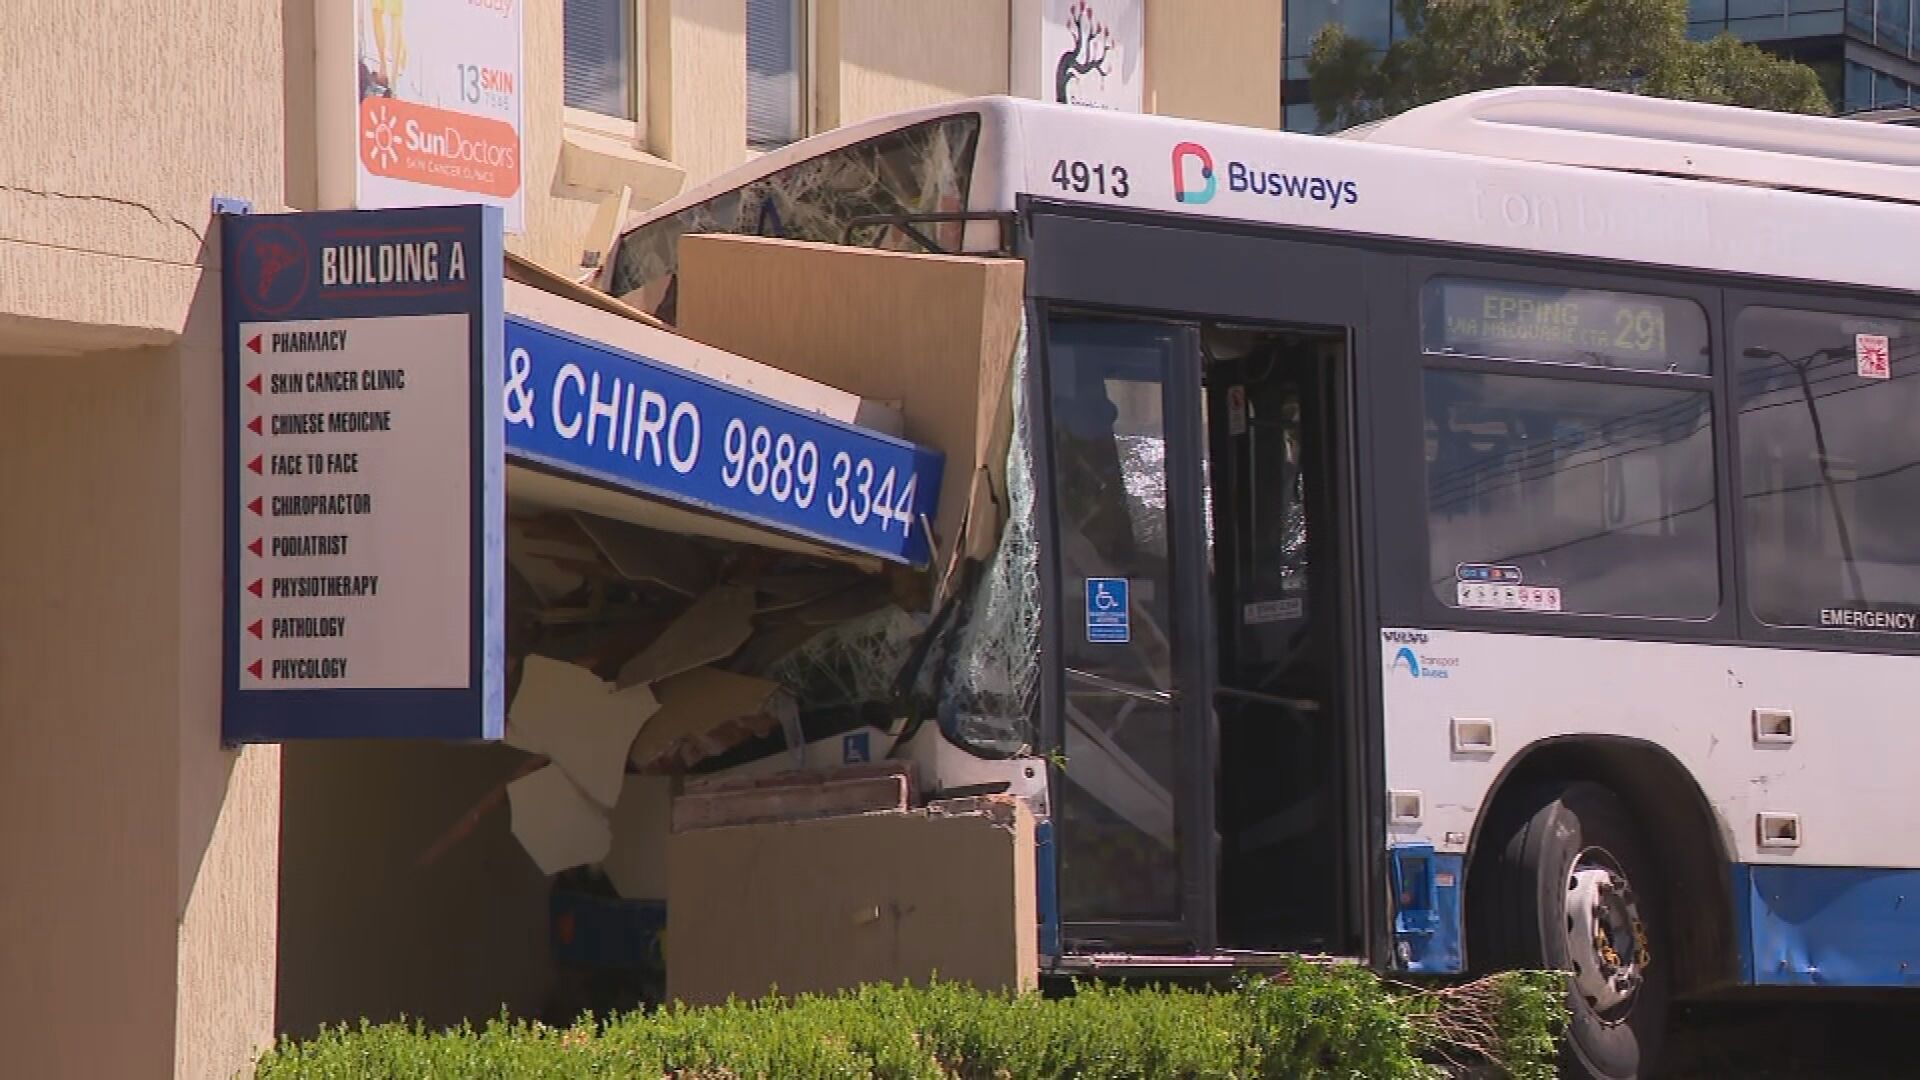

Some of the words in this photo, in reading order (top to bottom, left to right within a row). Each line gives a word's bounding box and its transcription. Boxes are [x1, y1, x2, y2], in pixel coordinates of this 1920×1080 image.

[457, 64, 480, 104] 13
[481, 68, 512, 94] SKIN
[405, 119, 514, 169] SunDoctors
[1051, 159, 1130, 198] 4913
[1228, 161, 1358, 209] Busways
[321, 242, 438, 285] BUILDING
[449, 241, 465, 281] A
[1483, 295, 1579, 325] EPPING
[271, 330, 347, 352] PHARMACY
[1614, 307, 1667, 352] 291
[271, 373, 303, 394] SKIN
[306, 371, 358, 392] CANCER
[362, 369, 405, 390] CLINIC
[271, 413, 325, 435] CHINESE
[328, 411, 391, 432] MEDICINE
[503, 347, 535, 429] &
[552, 363, 701, 473] CHIRO
[721, 418, 819, 509] 9889
[827, 452, 919, 538] 3344
[271, 455, 302, 475] FACE
[307, 454, 324, 475] TO
[327, 453, 358, 473] FACE
[271, 494, 371, 516] CHIROPRACTOR
[272, 535, 348, 557] PODIATRIST
[272, 576, 379, 598] PHYSIOTHERAPY
[272, 617, 345, 638] PATHOLOGY
[1821, 609, 1916, 629] EMERGENCY
[272, 658, 347, 679] PHYCOLOGY
